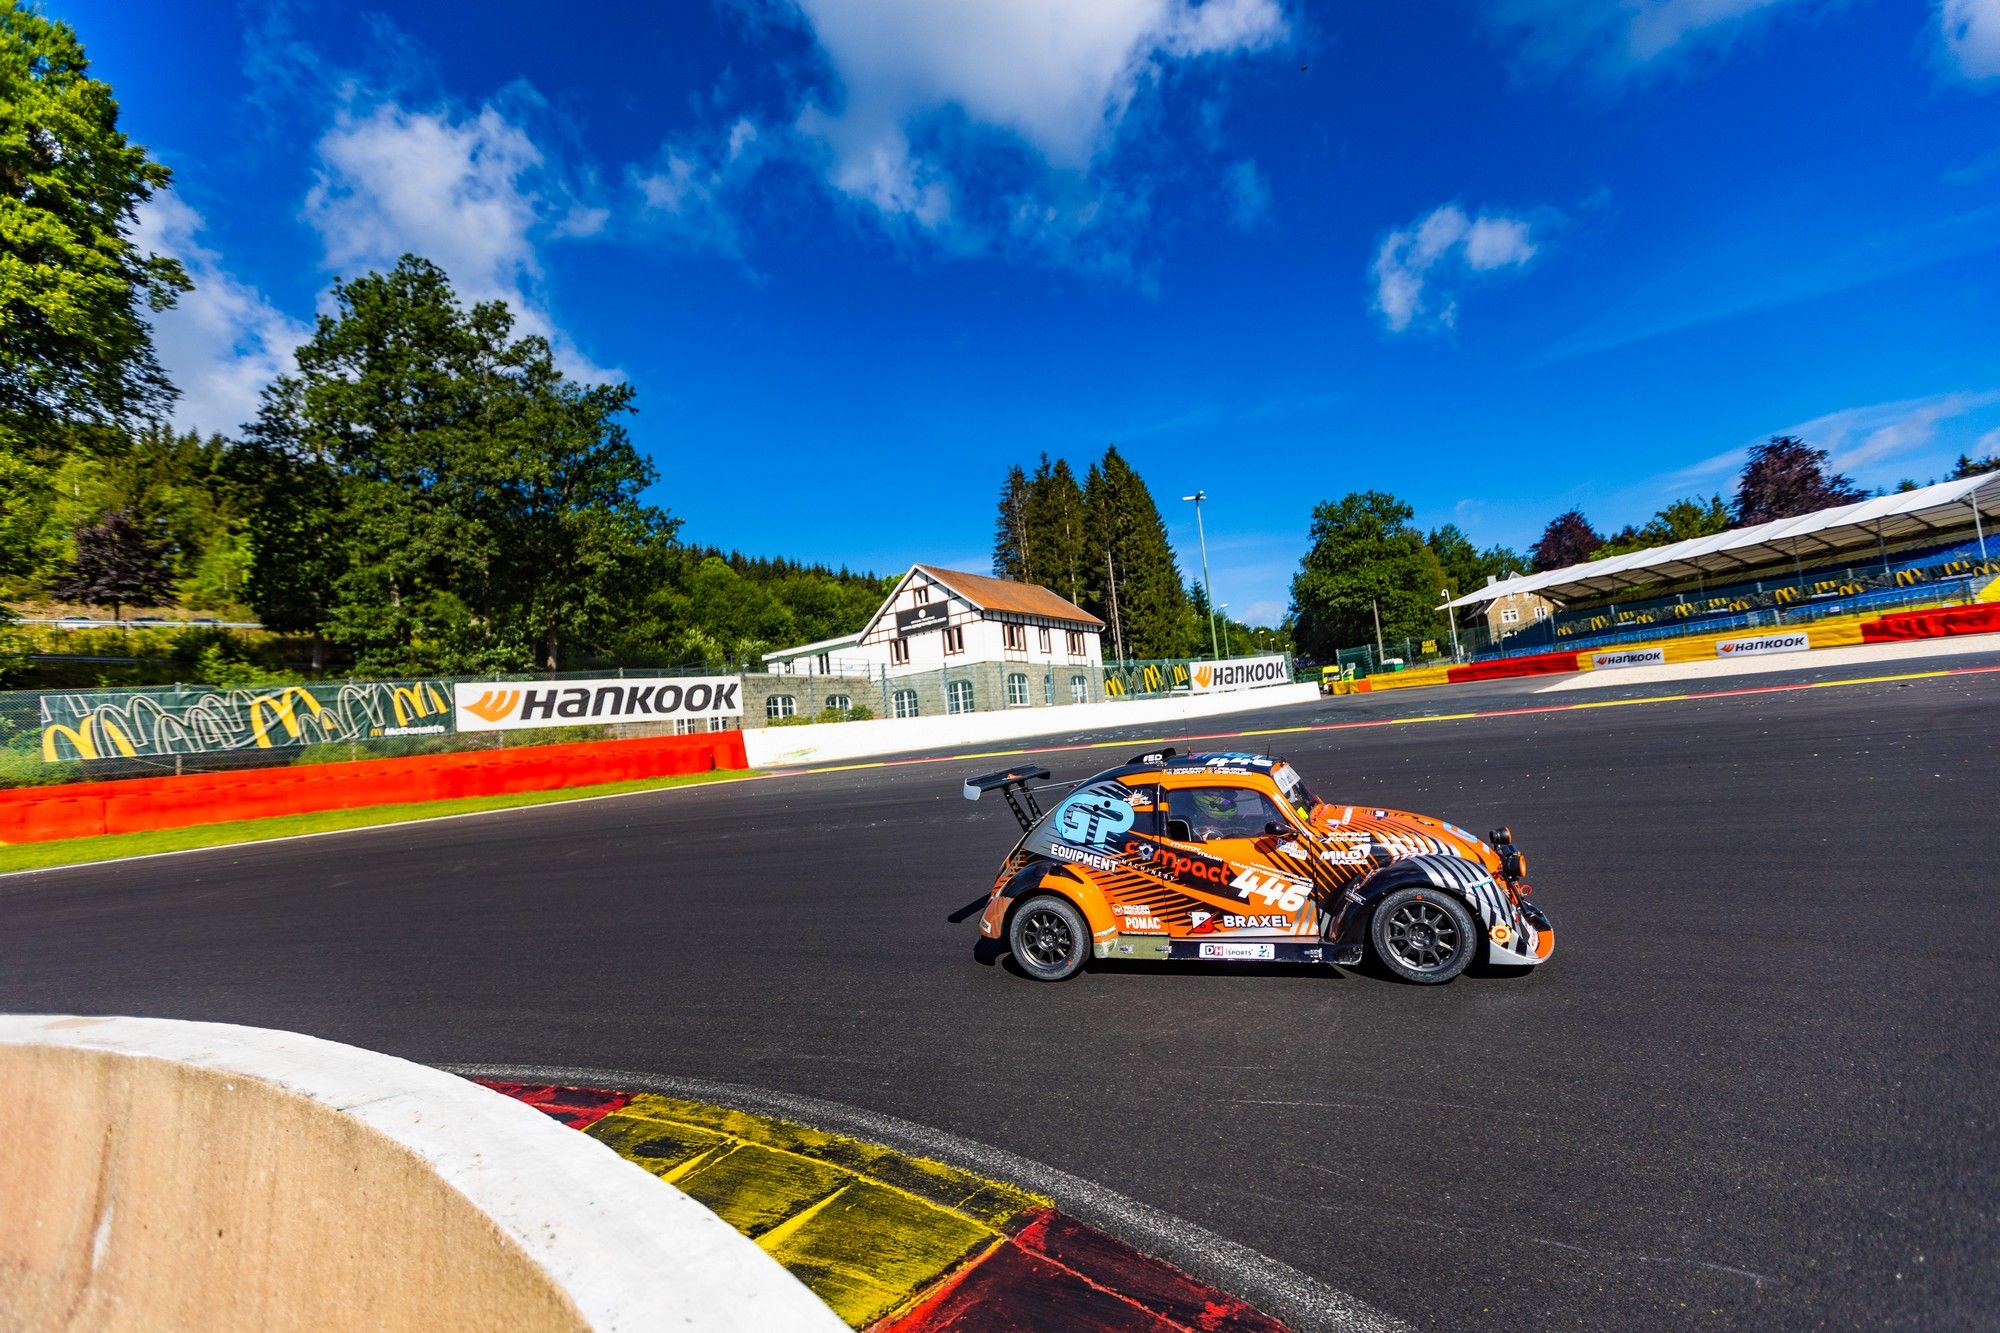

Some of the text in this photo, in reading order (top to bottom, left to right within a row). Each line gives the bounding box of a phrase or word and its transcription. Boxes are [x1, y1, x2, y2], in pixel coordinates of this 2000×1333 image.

[384, 725, 446, 737] McDonald's
[1055, 793, 1135, 849] GP
[1051, 843, 1119, 872] EQUIPMENT
[1121, 859, 1176, 881] MACHINERY
[1229, 868, 1313, 912] 446
[1125, 917, 1161, 929] POMAC
[1223, 915, 1292, 928] BRAXEL
[1205, 945, 1224, 956] DH
